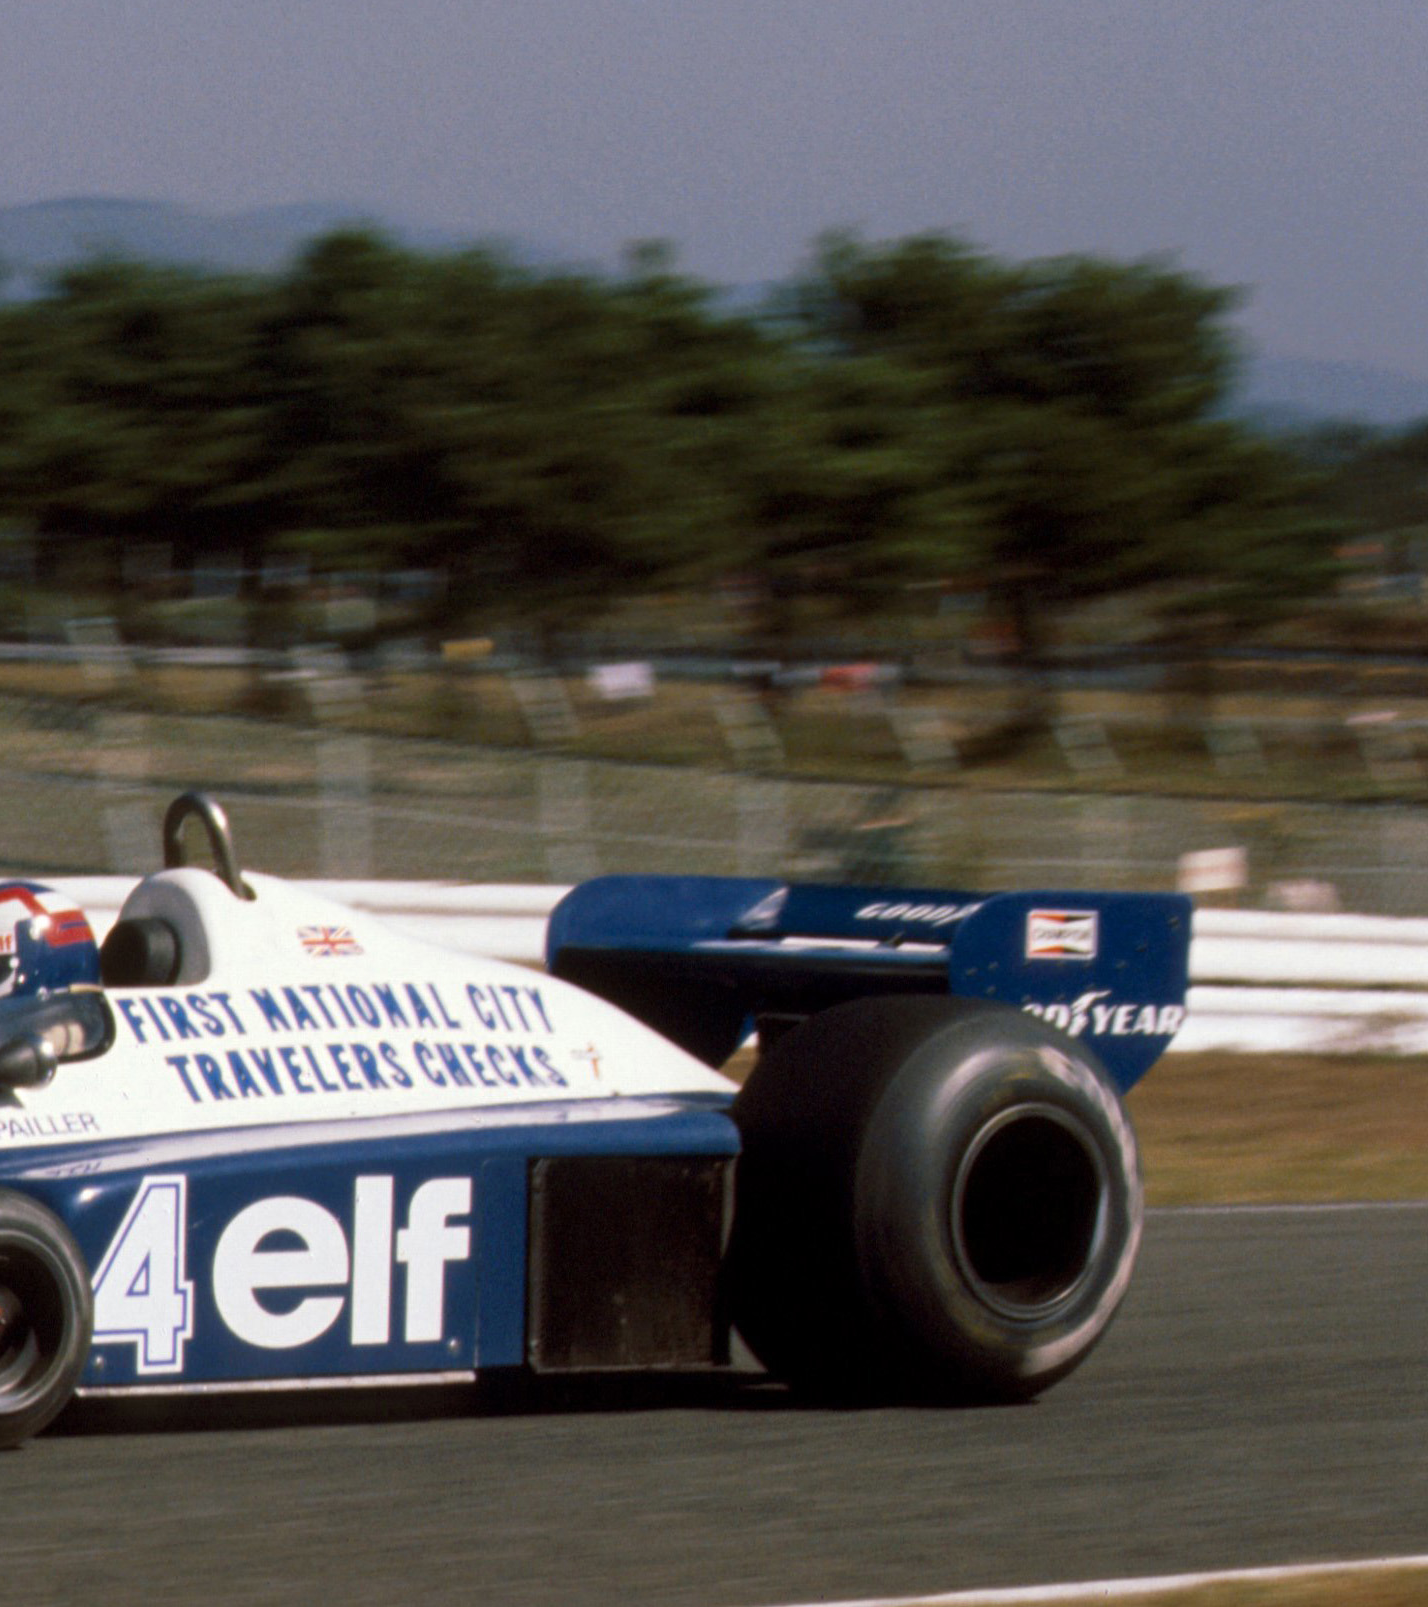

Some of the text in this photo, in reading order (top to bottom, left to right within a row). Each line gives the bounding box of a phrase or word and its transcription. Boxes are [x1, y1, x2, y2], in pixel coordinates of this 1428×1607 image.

[854, 902, 983, 927] GOOD
[115, 982, 555, 1044] FIRST NATIONAL CITY
[165, 1039, 570, 1104] TRAVELERS CHECKS
[91, 1173, 472, 1375] 4 elf
